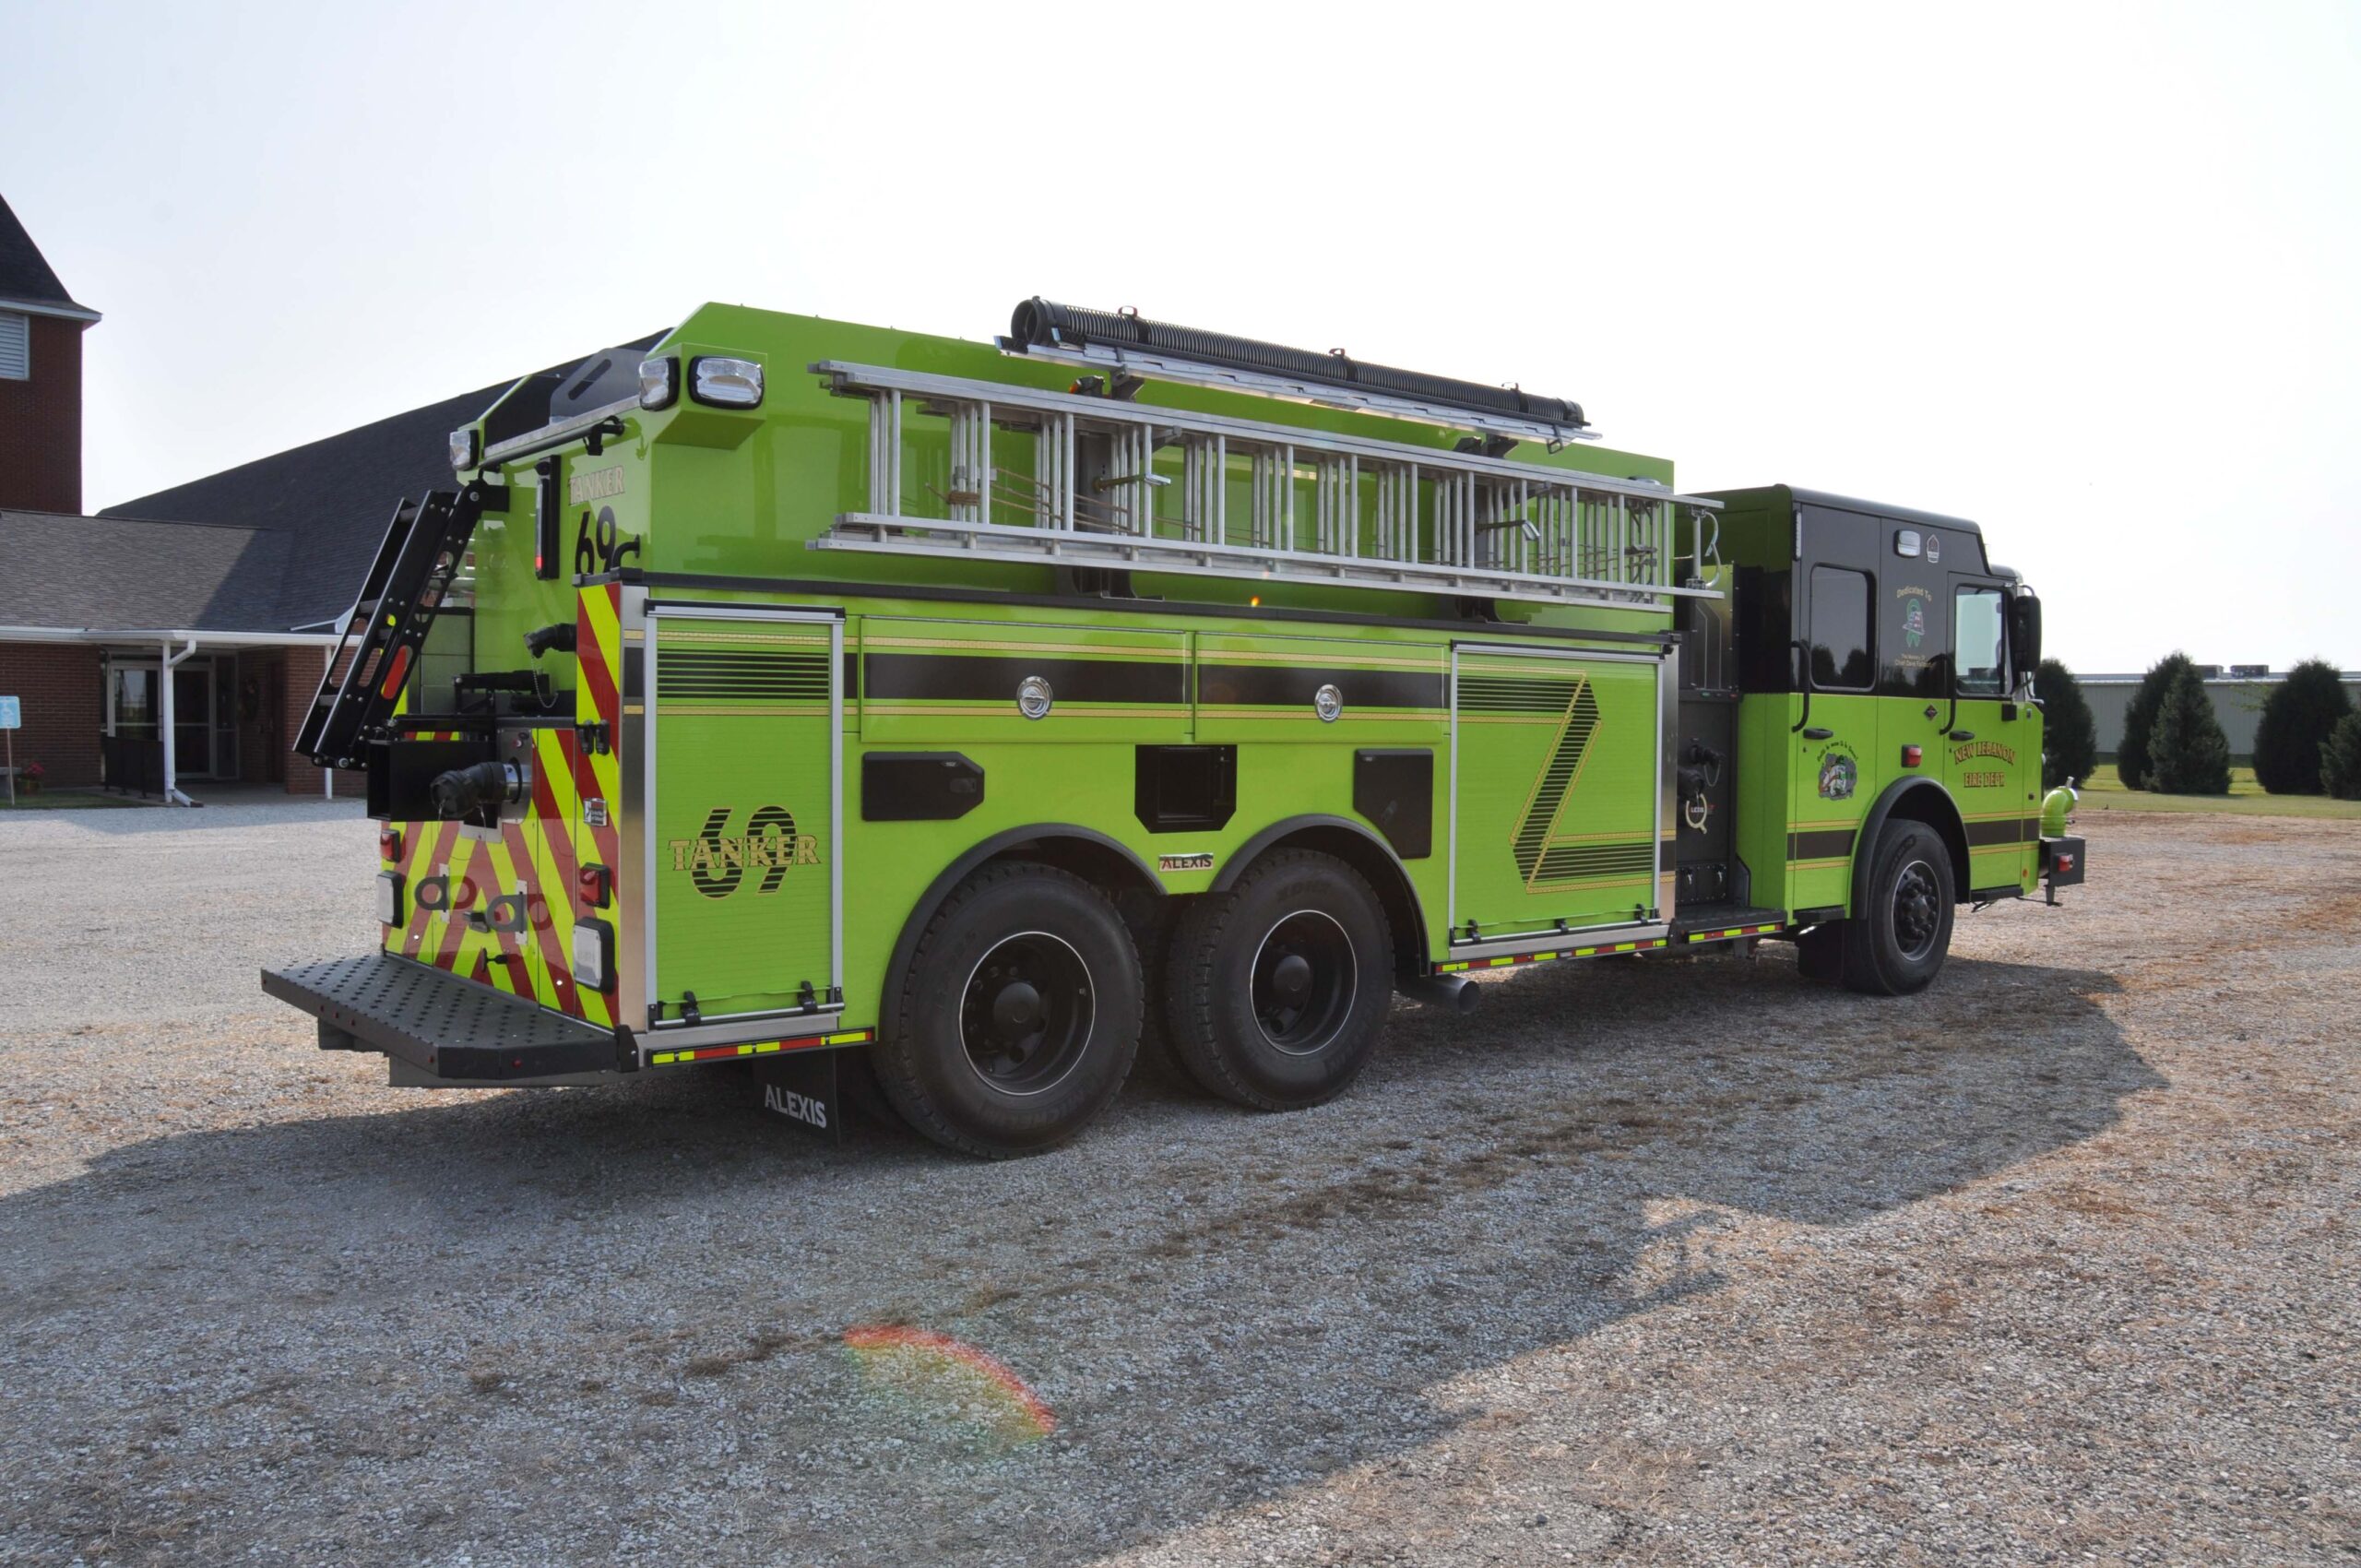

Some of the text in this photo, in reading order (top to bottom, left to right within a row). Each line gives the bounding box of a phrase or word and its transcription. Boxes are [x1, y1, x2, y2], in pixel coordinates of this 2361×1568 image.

[568, 465, 625, 506] TANKER
[575, 505, 617, 575] 69
[1954, 742, 2015, 766] NEW LEBANON
[1964, 772, 2005, 788] FIRE DEPT
[668, 835, 821, 872] TANKER
[691, 805, 797, 900] 69
[1161, 856, 1212, 869] ALEXIS
[765, 1084, 827, 1128] ALEXIS
